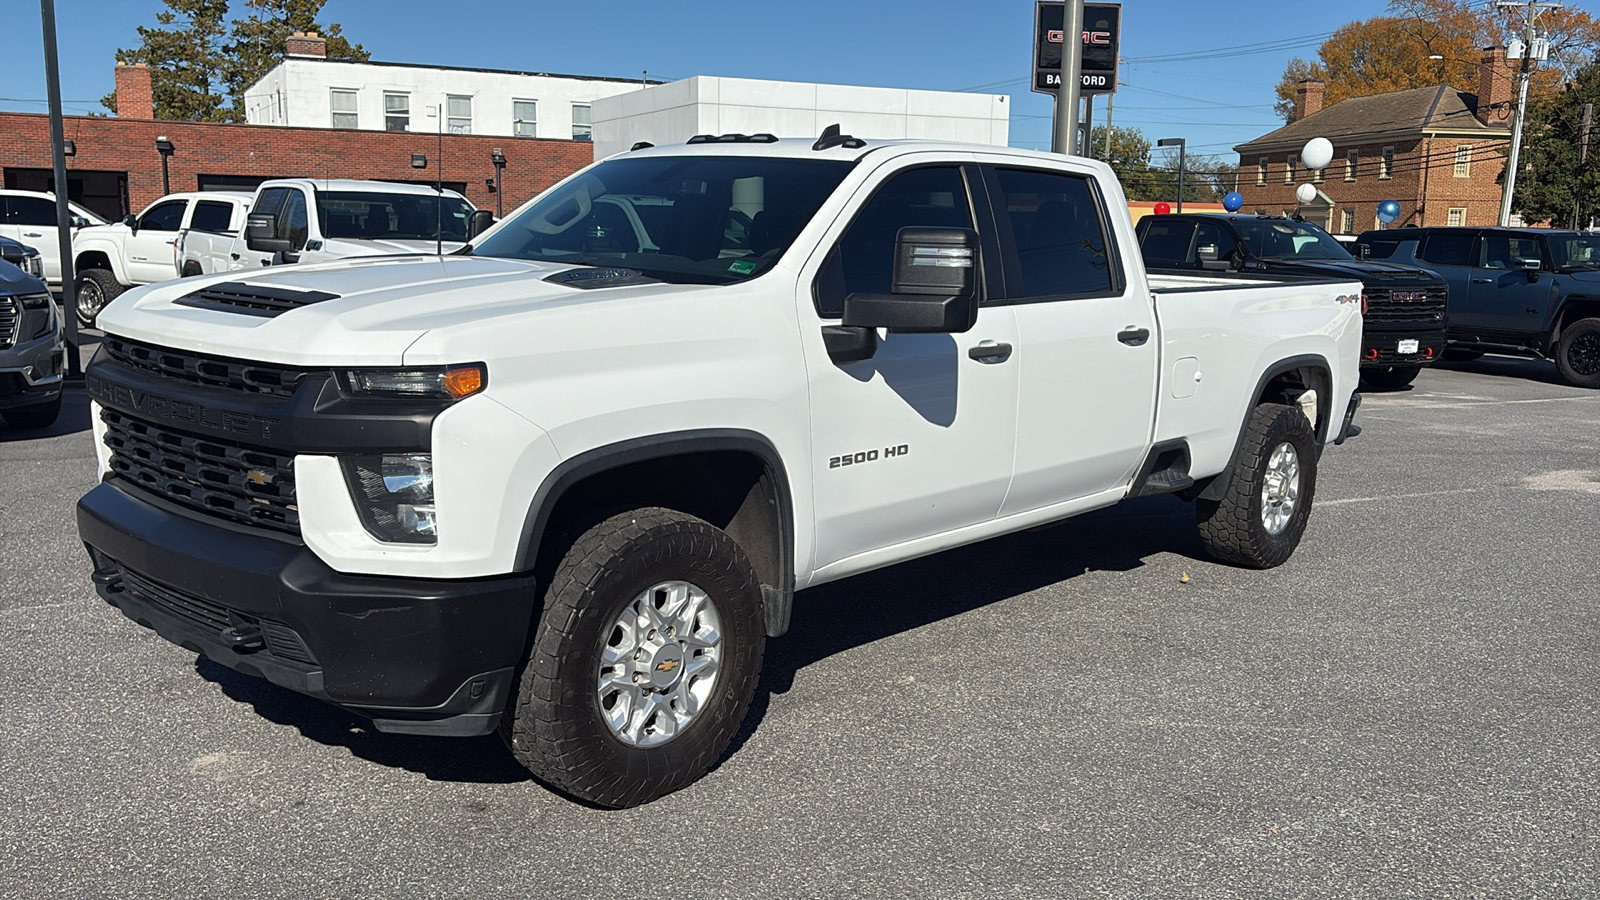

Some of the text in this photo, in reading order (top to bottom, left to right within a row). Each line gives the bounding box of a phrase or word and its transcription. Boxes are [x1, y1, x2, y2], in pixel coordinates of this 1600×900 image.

[87, 375, 281, 440] CHEVROLET
[829, 444, 909, 469] 2500 HD
